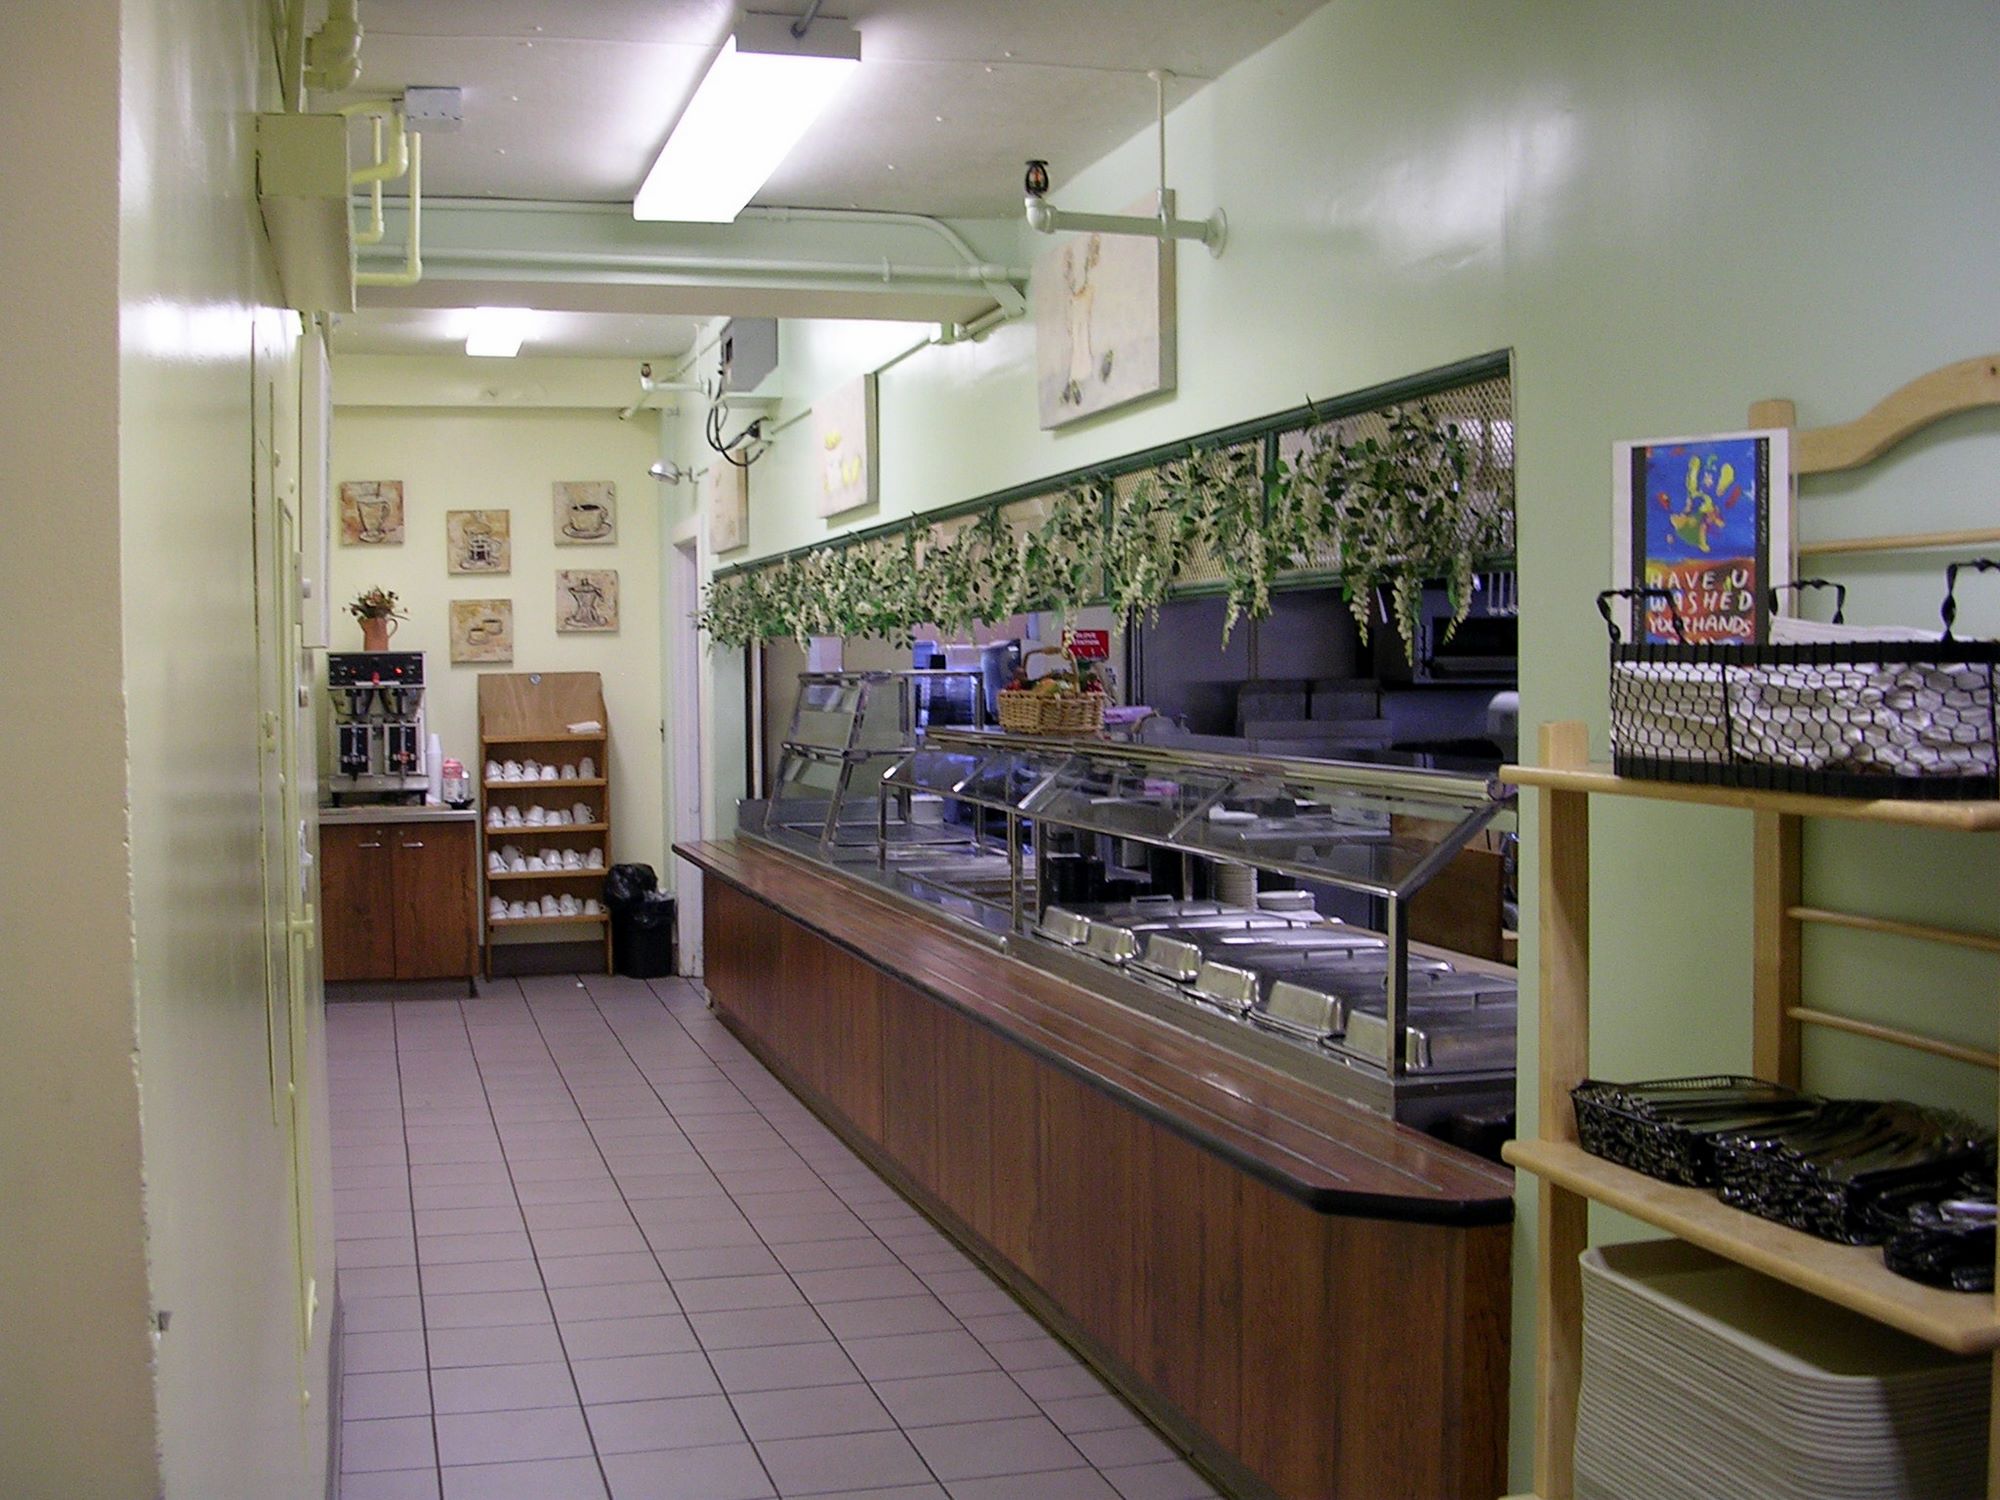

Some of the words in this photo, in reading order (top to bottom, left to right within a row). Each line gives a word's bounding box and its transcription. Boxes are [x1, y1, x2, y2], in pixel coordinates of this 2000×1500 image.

[1649, 571, 1716, 589] HAVE
[1731, 568, 1748, 588] U
[1649, 590, 1753, 614] WASHED
[1692, 614, 1753, 637] HANDS
